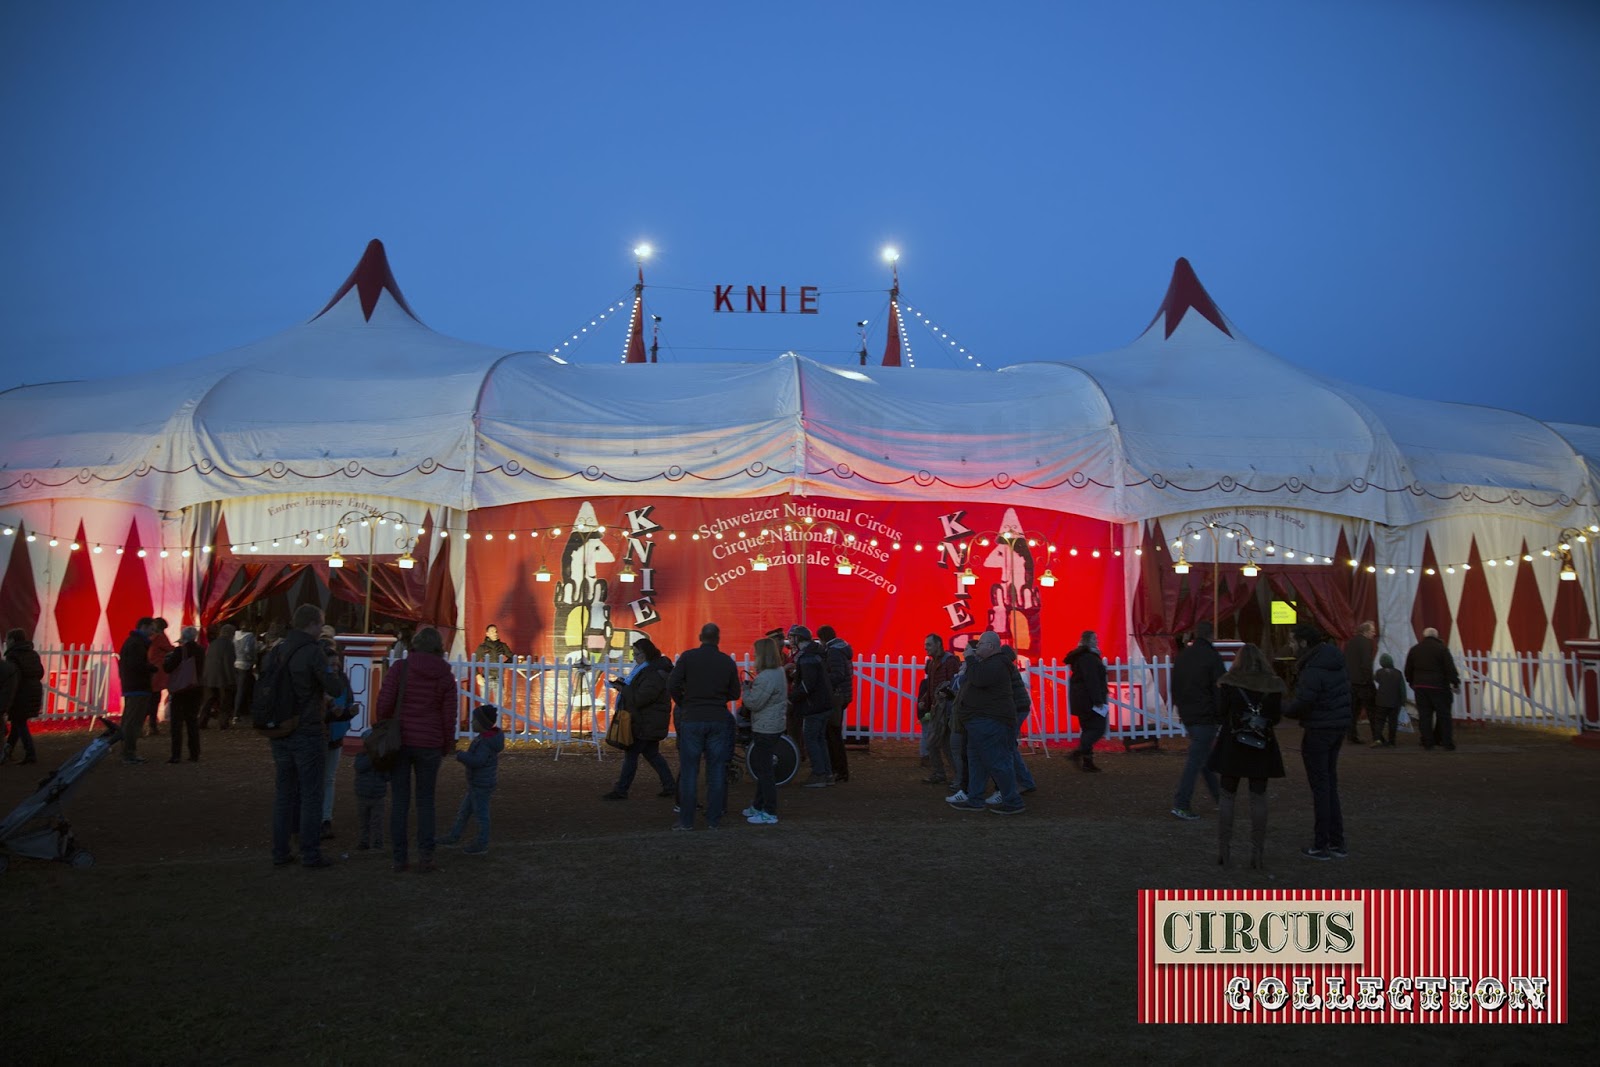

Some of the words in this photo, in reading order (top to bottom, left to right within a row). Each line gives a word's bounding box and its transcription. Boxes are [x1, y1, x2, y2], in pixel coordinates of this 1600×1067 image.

[714, 284, 818, 314] KNIE
[305, 496, 343, 508] Eingang
[699, 507, 779, 539] Schweizer
[783, 502, 850, 523] National
[855, 512, 903, 541] Circus
[712, 534, 766, 560] Cirque
[769, 527, 837, 545] National
[842, 533, 890, 562] Suisse
[623, 505, 663, 628] KNIE
[704, 565, 746, 592] Circo
[835, 554, 898, 595] Sizzero
[937, 510, 975, 631] KNIE
